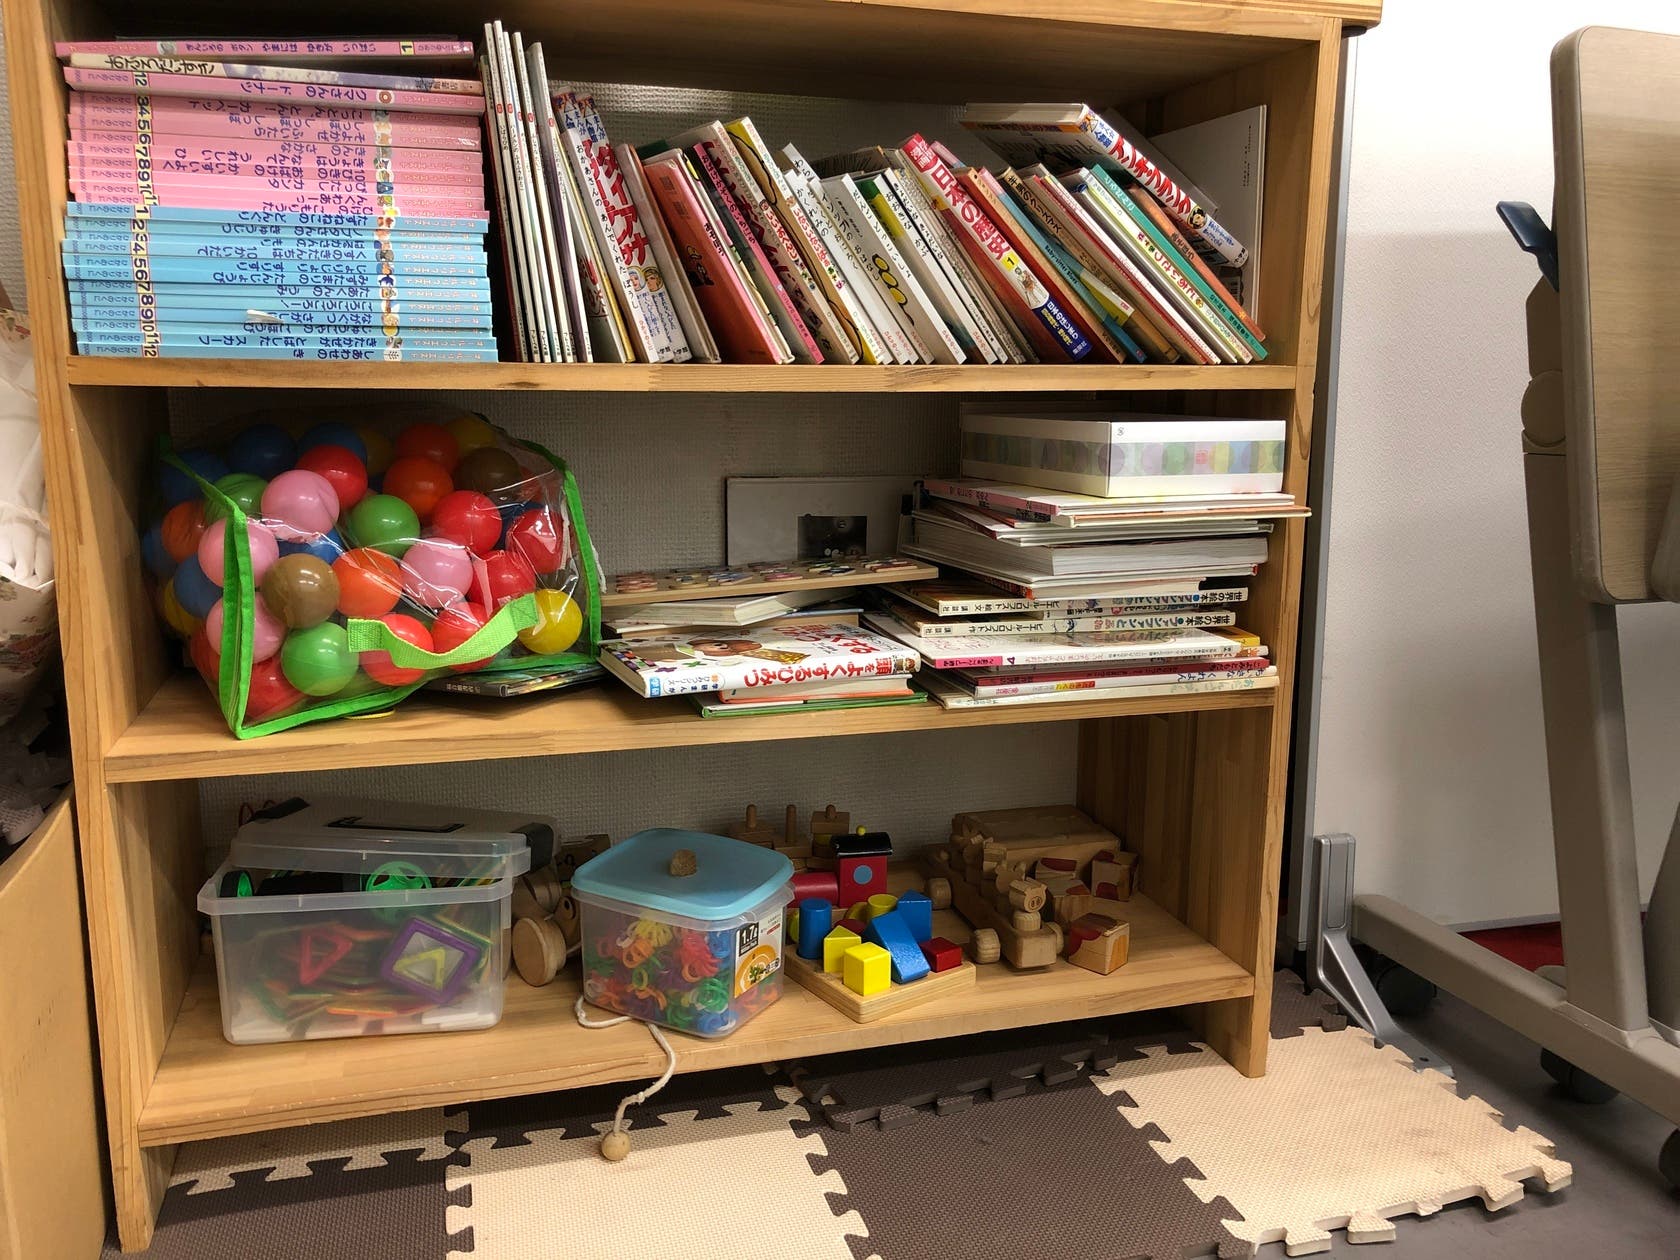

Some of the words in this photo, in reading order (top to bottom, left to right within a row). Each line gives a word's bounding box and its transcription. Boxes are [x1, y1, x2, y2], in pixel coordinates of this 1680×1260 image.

[104, 56, 214, 75] おふろだいすき
[135, 72, 147, 86] 12
[241, 82, 291, 95] ドーナツ
[306, 86, 367, 101] クマさんの
[138, 96, 148, 106] 3
[139, 106, 149, 115] 4
[138, 119, 150, 130] 5
[591, 115, 606, 140] まんが
[254, 127, 303, 138] ふいたら
[317, 130, 365, 143] そよかぜ
[1091, 127, 1113, 148] 人物館
[139, 134, 152, 144] 6
[136, 146, 148, 157] 7
[175, 148, 186, 158] ひ
[280, 143, 317, 153] さかな
[331, 145, 365, 156] きんの
[202, 150, 252, 162] うれしい
[266, 154, 301, 165] なんて
[909, 146, 930, 168] 漫画
[138, 159, 150, 170] 8
[163, 160, 239, 174] かいすいよく
[317, 156, 364, 168] きょうは
[138, 171, 149, 182] 9
[254, 165, 303, 177] おばけの
[1108, 136, 1197, 218] アンネ・フランク
[267, 178, 303, 190] カンタ
[598, 143, 650, 264] ダイアナ
[699, 153, 757, 245] おばけかぞくのいちにち
[1006, 173, 1064, 234] 羊男のクリスマス
[136, 206, 149, 214] 1
[795, 187, 829, 237] かくれみの
[930, 163, 1012, 260] 日本の歴史
[239, 211, 285, 222] どんぐり
[299, 213, 367, 226] たずねねこの
[133, 219, 145, 230] 2
[222, 223, 279, 234] きゅうじつ
[575, 143, 602, 207] おかあさんの
[599, 213, 627, 275] あんでくれた
[622, 278, 639, 309] ぼうし
[883, 190, 913, 230] おおきな
[912, 237, 930, 257] かぶ
[819, 191, 855, 241] イソップの
[852, 244, 881, 282] おはなし
[133, 243, 145, 253] 4
[197, 246, 257, 258] 10かいだて
[272, 248, 366, 260] くすのきだんちは
[134, 258, 146, 268] 5
[237, 261, 284, 271] すりすり
[297, 262, 367, 273] じょりじょり
[136, 269, 148, 280] 6
[213, 272, 285, 284] たんじょうび
[298, 274, 368, 286] みずたまりの
[138, 283, 150, 291] 7
[277, 285, 299, 296] うみ
[313, 286, 369, 297] たあくんの
[141, 295, 153, 305] 8
[141, 309, 153, 319] 9
[326, 313, 372, 324] ながぐつ
[1046, 300, 1079, 340] 日本のはじまり
[142, 321, 156, 332] 10
[147, 333, 159, 344] 11
[199, 335, 247, 346] スカーフ
[260, 336, 305, 346] とばした
[319, 337, 376, 348] きたかぜが
[144, 344, 157, 356] 12
[293, 349, 304, 358] き
[317, 348, 373, 360] しあわせの
[1200, 591, 1242, 601] 世界の絵本
[1185, 615, 1229, 624] 世界の絵本
[742, 657, 892, 687] 頭をよくするひみつ
[1176, 671, 1216, 682] くれよん
[1225, 668, 1264, 678] ちいさな
[648, 677, 660, 696] 学研
[668, 676, 709, 686] ひみつシリーズ
[667, 682, 718, 694] 学研まんが
